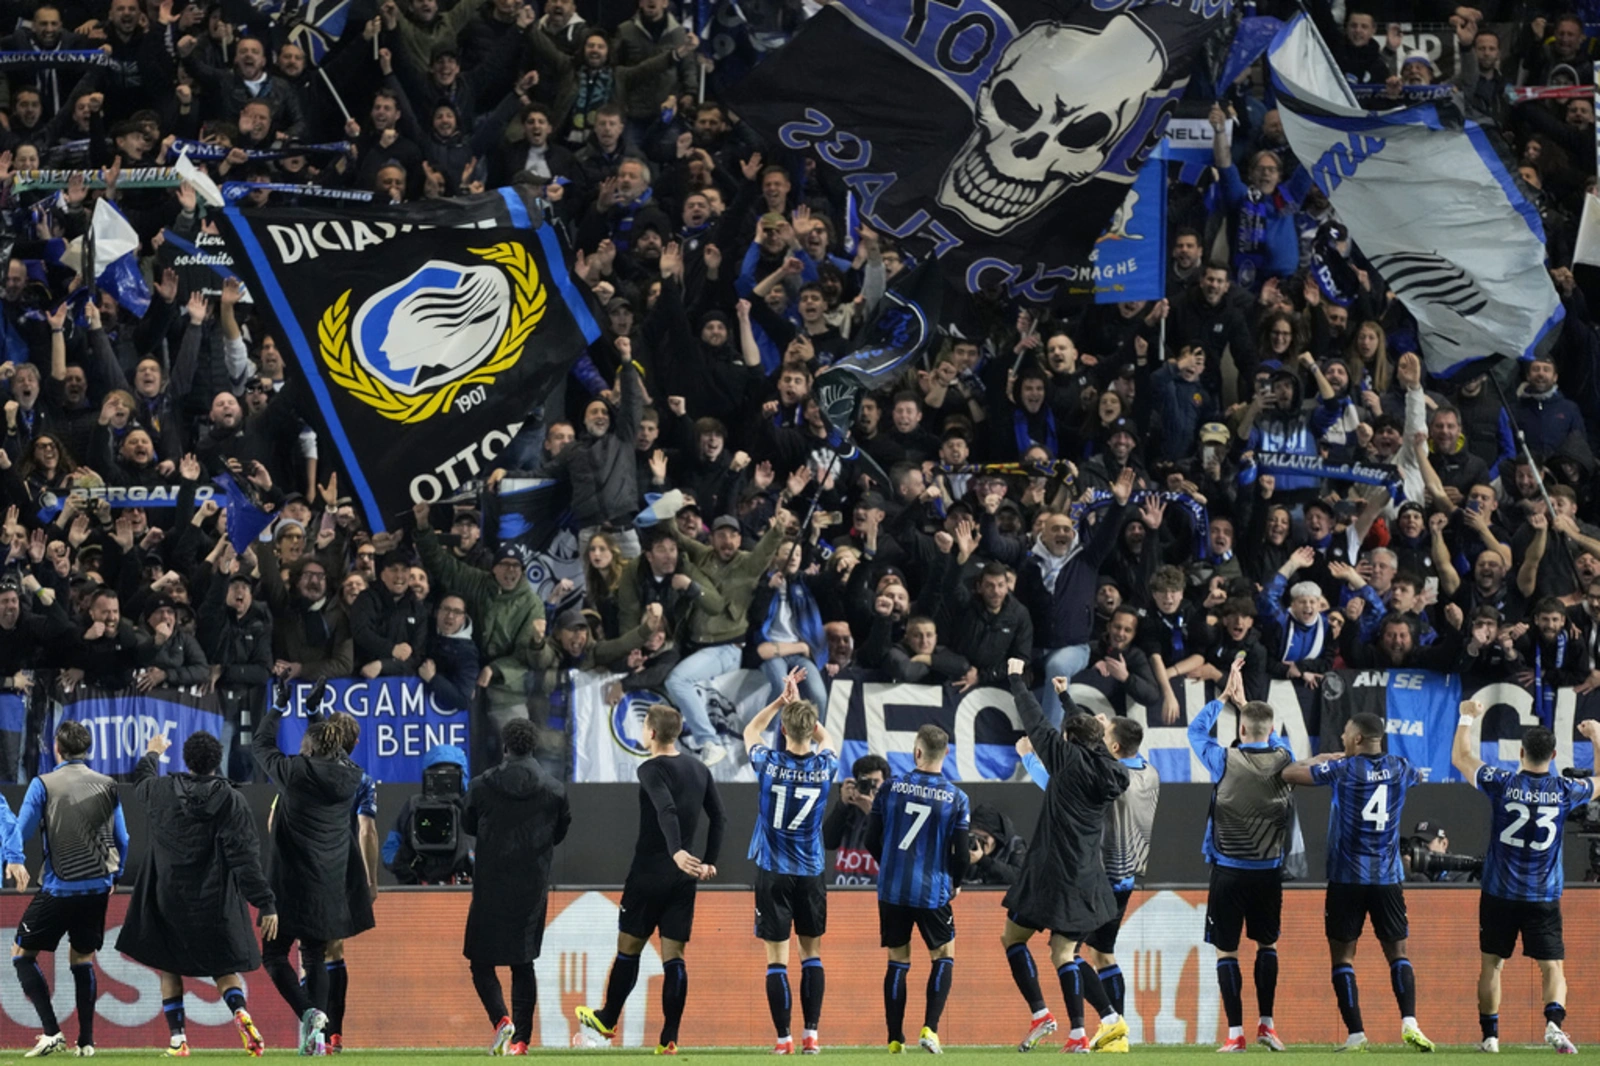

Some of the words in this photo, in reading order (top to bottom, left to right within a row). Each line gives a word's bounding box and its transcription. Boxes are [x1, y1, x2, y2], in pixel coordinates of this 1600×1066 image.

[39, 169, 93, 184] NEVR
[455, 385, 488, 414] 1907
[409, 421, 524, 505] OTTO
[377, 724, 465, 756] BENE
[771, 784, 821, 831] 17
[891, 781, 954, 804] KOOPMEINERS
[1361, 784, 1389, 831] 4
[898, 801, 932, 851] 7
[1500, 801, 1560, 851] 23
[836, 850, 880, 870] HOT
